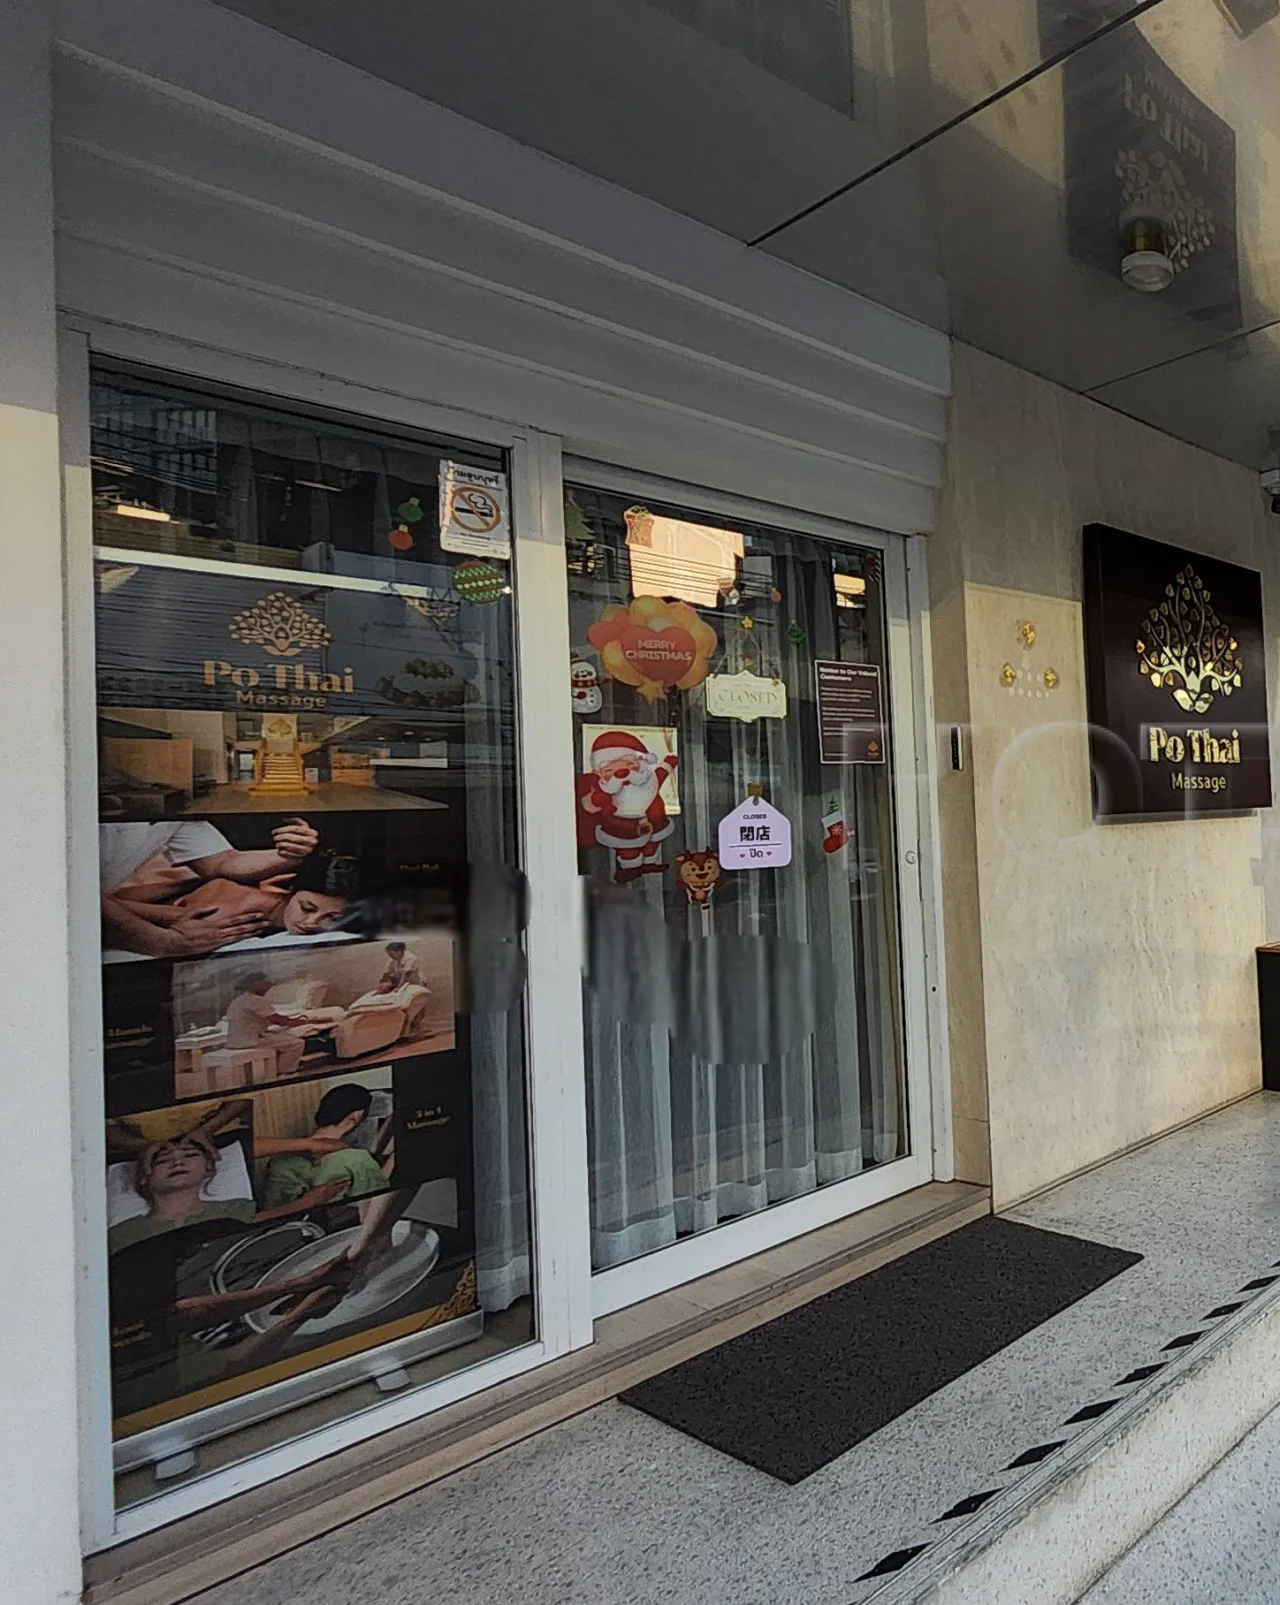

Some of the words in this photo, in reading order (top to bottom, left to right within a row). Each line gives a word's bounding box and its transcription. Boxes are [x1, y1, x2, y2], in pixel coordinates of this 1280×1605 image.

[637, 639, 677, 650] MERRY
[625, 650, 692, 661] CHRISTMAS
[204, 660, 260, 686] Po
[267, 664, 354, 693] Thai
[236, 690, 327, 709] Massage
[718, 688, 778, 705] CLOSED
[1149, 727, 1185, 763] Po
[1187, 728, 1240, 764] Thai
[1171, 772, 1227, 793] Massage
[749, 848, 764, 858] ปิด
